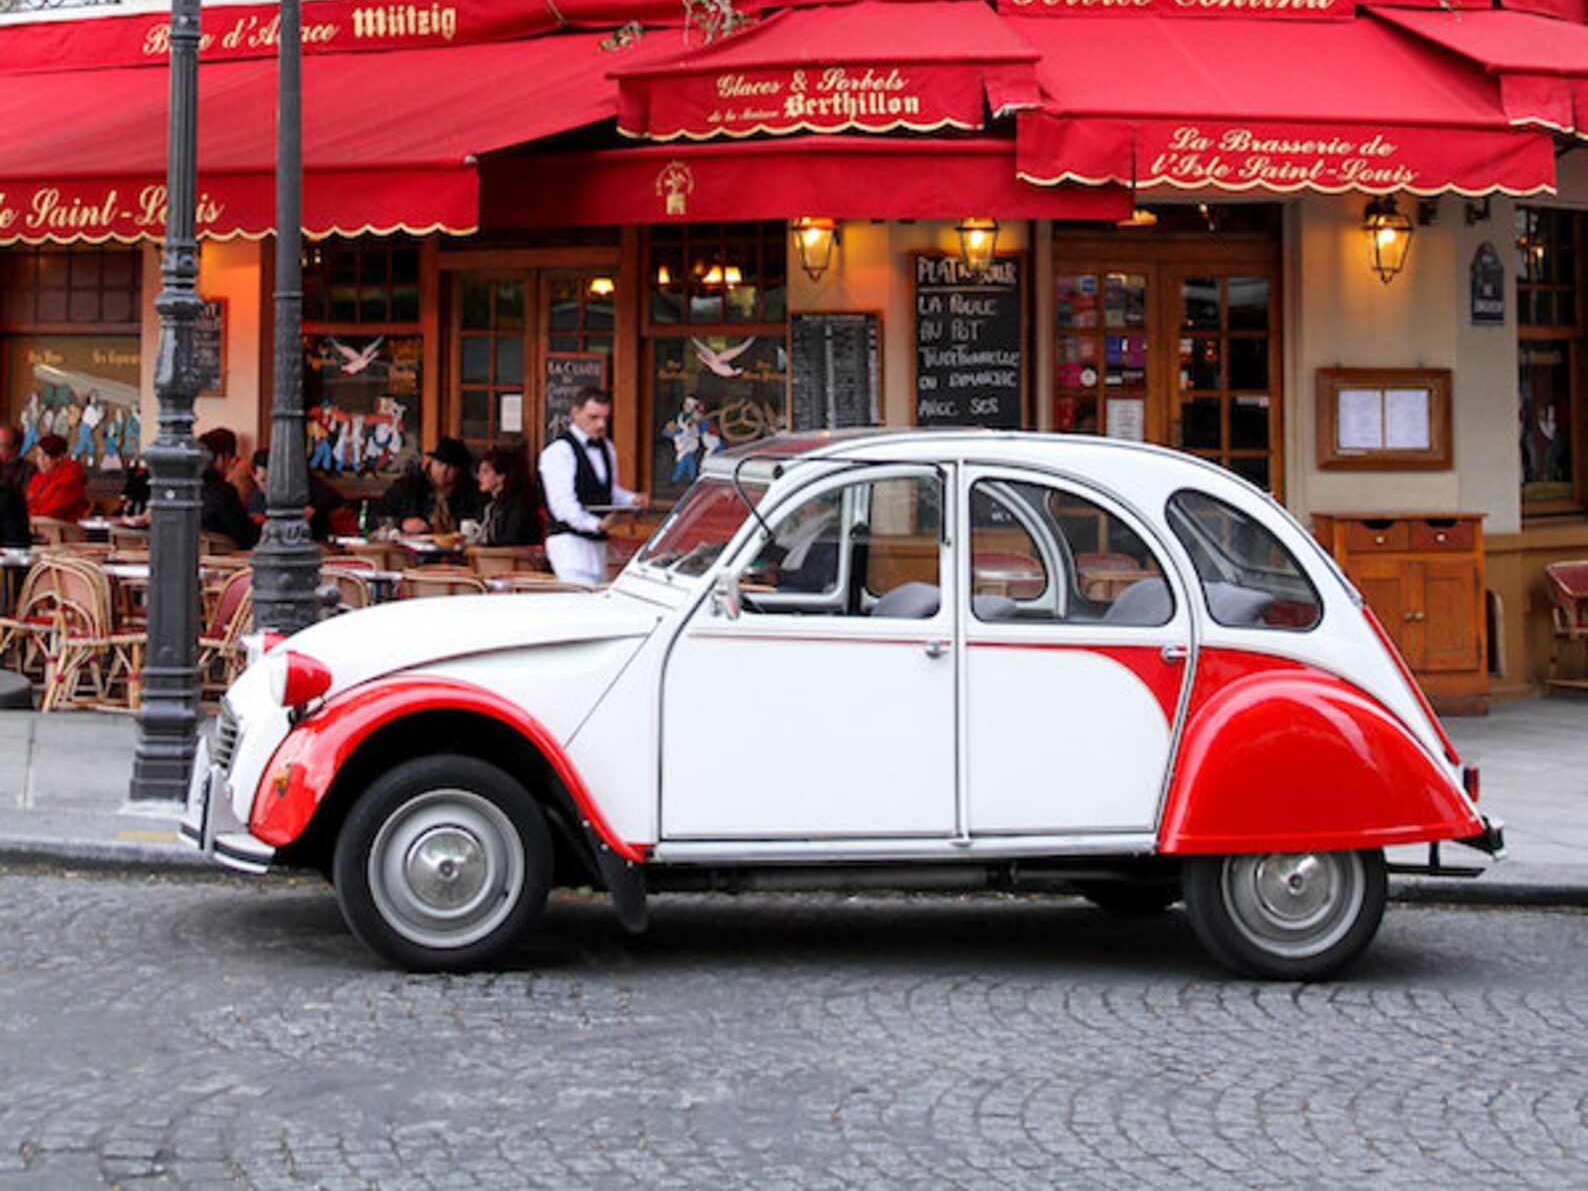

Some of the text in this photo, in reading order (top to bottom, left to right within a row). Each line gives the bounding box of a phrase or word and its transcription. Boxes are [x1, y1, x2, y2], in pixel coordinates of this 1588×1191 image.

[222, 14, 341, 49] d'Aace
[716, 67, 909, 98] Glaces & Sorbets
[784, 91, 920, 123] Berthillon
[1169, 127, 1397, 156] La Brasserie de
[1151, 154, 1419, 183] l'Isle Saint-Louis
[26, 185, 224, 228] Saint-Lois
[918, 256, 957, 284] PLAT
[918, 295, 942, 314] LA
[951, 317, 986, 341] POT
